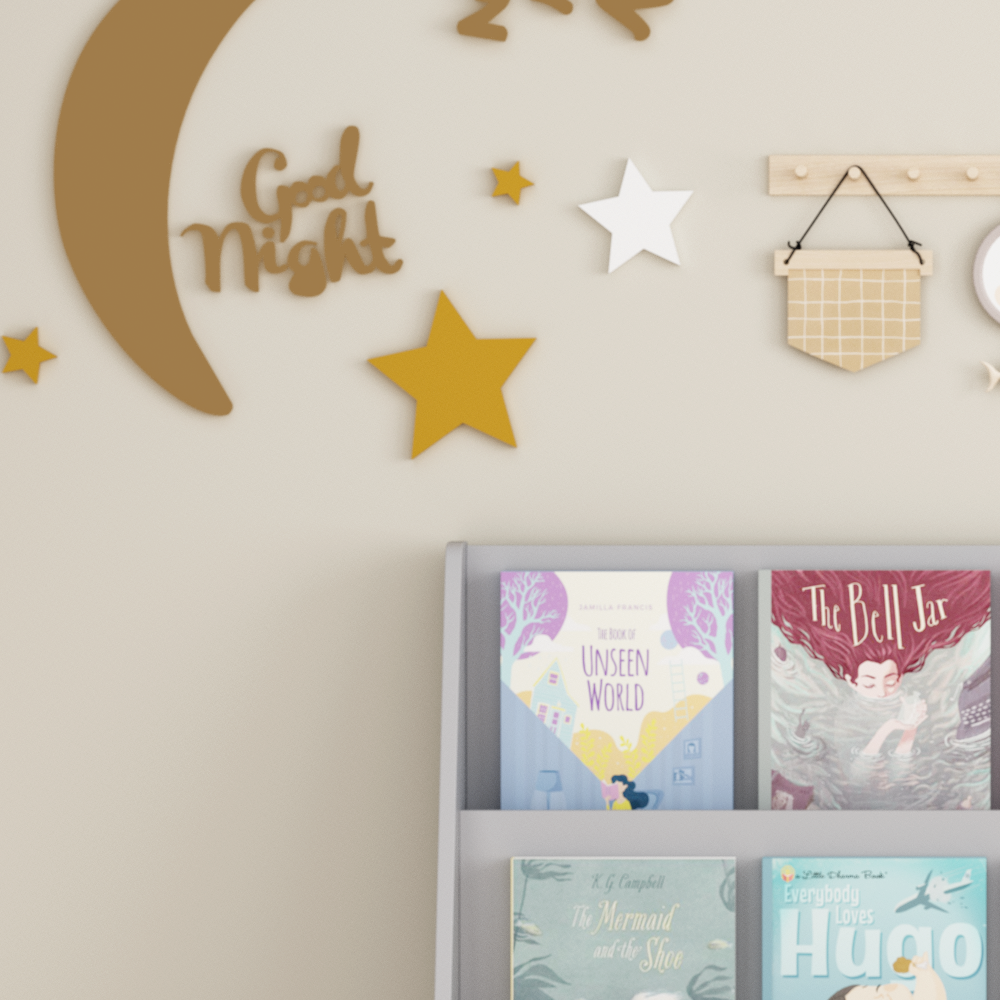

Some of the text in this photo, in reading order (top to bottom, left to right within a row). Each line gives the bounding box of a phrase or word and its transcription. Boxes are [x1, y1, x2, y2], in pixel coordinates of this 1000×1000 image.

[240, 125, 374, 243] Good
[180, 200, 404, 297] Night
[802, 582, 949, 650] The Bell Jar
[582, 645, 650, 677] UNSEEN
[587, 678, 645, 712] WORLD
[618, 873, 666, 893] Campbell
[784, 883, 860, 908] Everybody
[571, 900, 680, 936] The Mermaid
[835, 906, 875, 925] Loves
[593, 936, 683, 973] and the Shoe
[780, 908, 984, 984] Hugo
